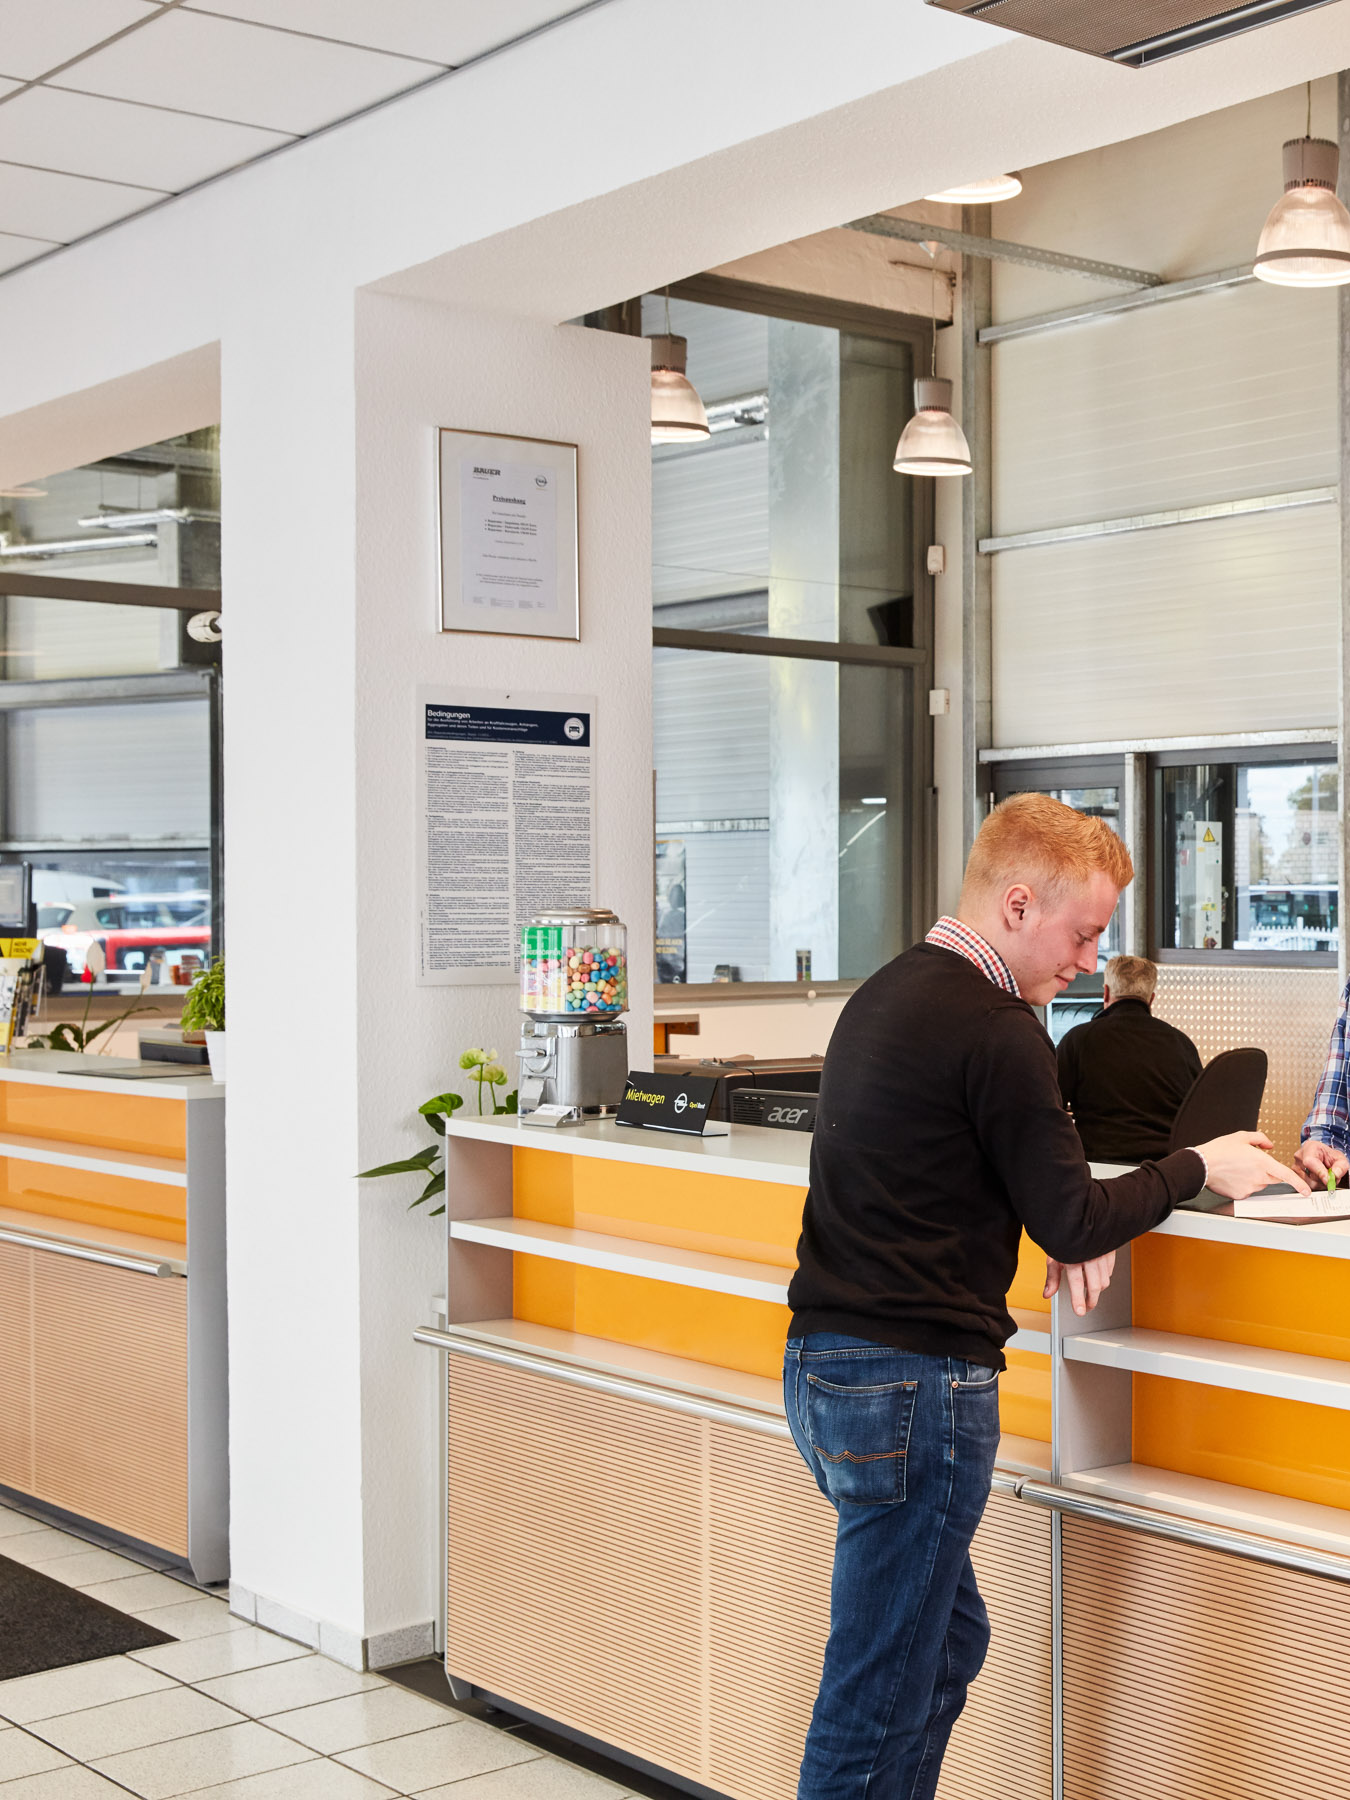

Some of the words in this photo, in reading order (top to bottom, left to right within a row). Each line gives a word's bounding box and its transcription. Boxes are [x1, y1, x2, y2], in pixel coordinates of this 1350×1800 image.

[473, 466, 501, 477] BAUER
[427, 709, 471, 719] Bedingungen
[625, 1088, 666, 1106] Mietwagen
[767, 1106, 809, 1124] acer
